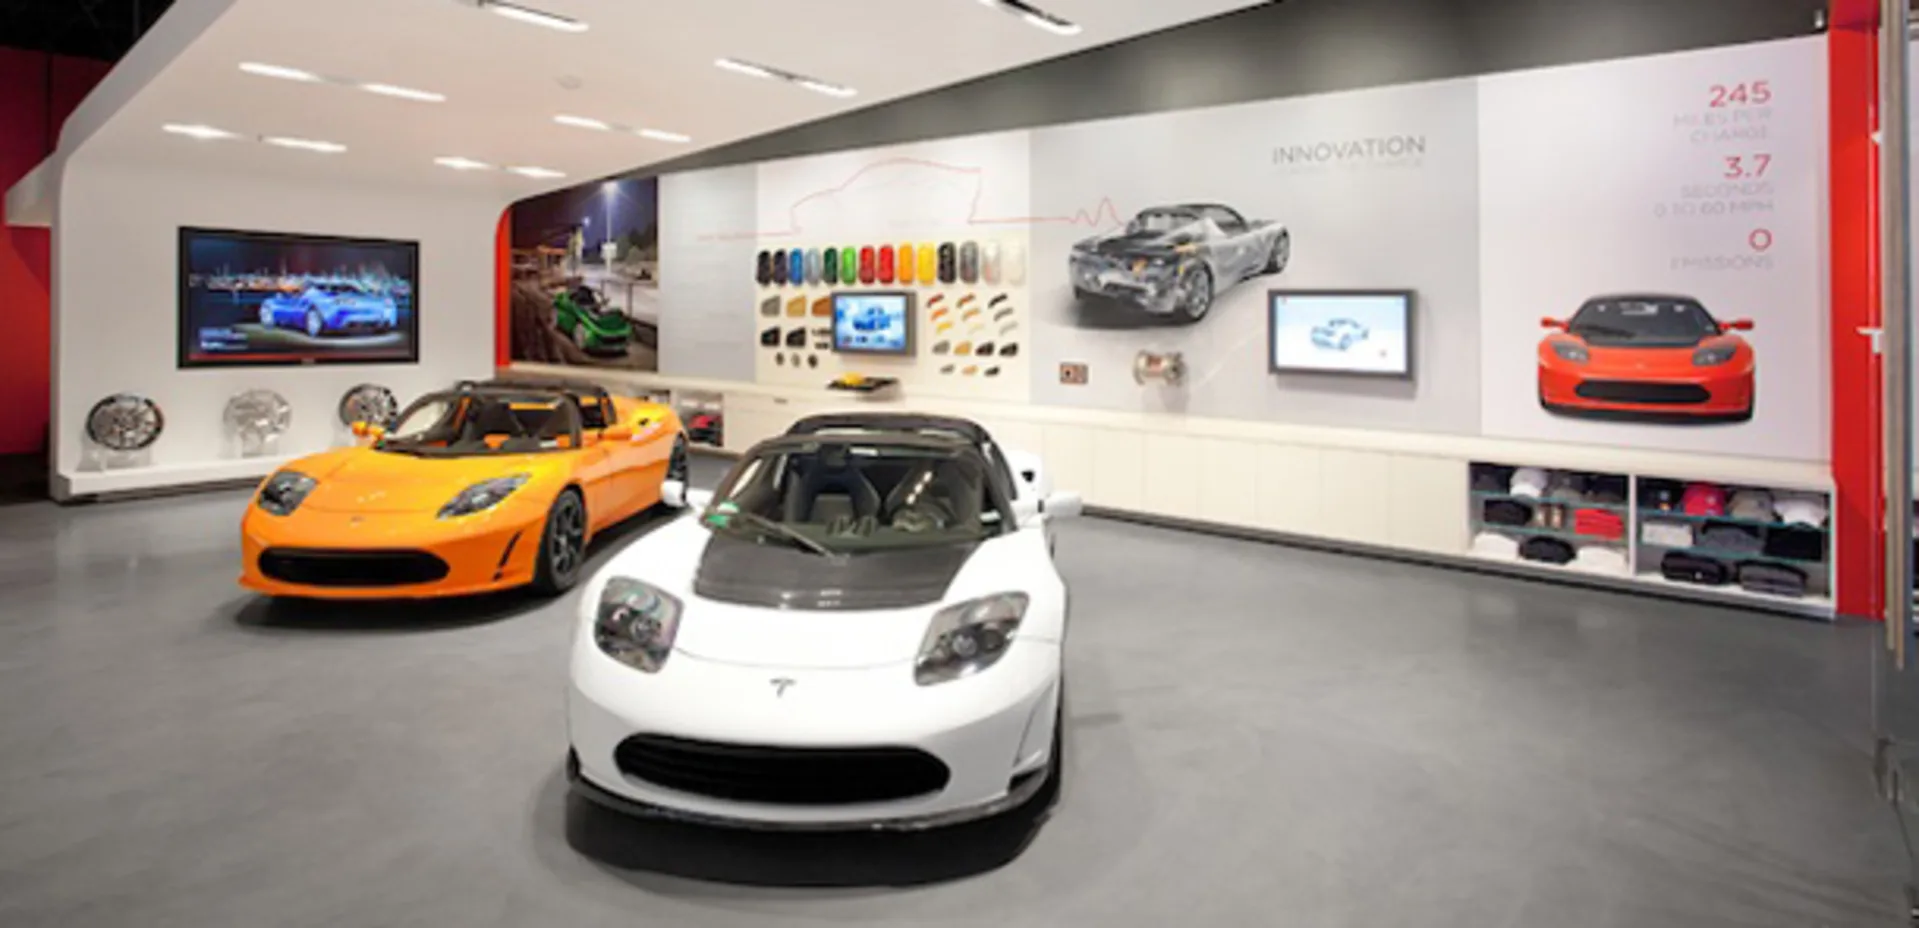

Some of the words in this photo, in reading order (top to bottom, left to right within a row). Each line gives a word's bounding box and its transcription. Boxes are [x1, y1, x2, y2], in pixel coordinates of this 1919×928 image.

[1709, 80, 1772, 108] 245
[1272, 135, 1426, 165] INNOVATION
[1724, 153, 1772, 179] 3.7
